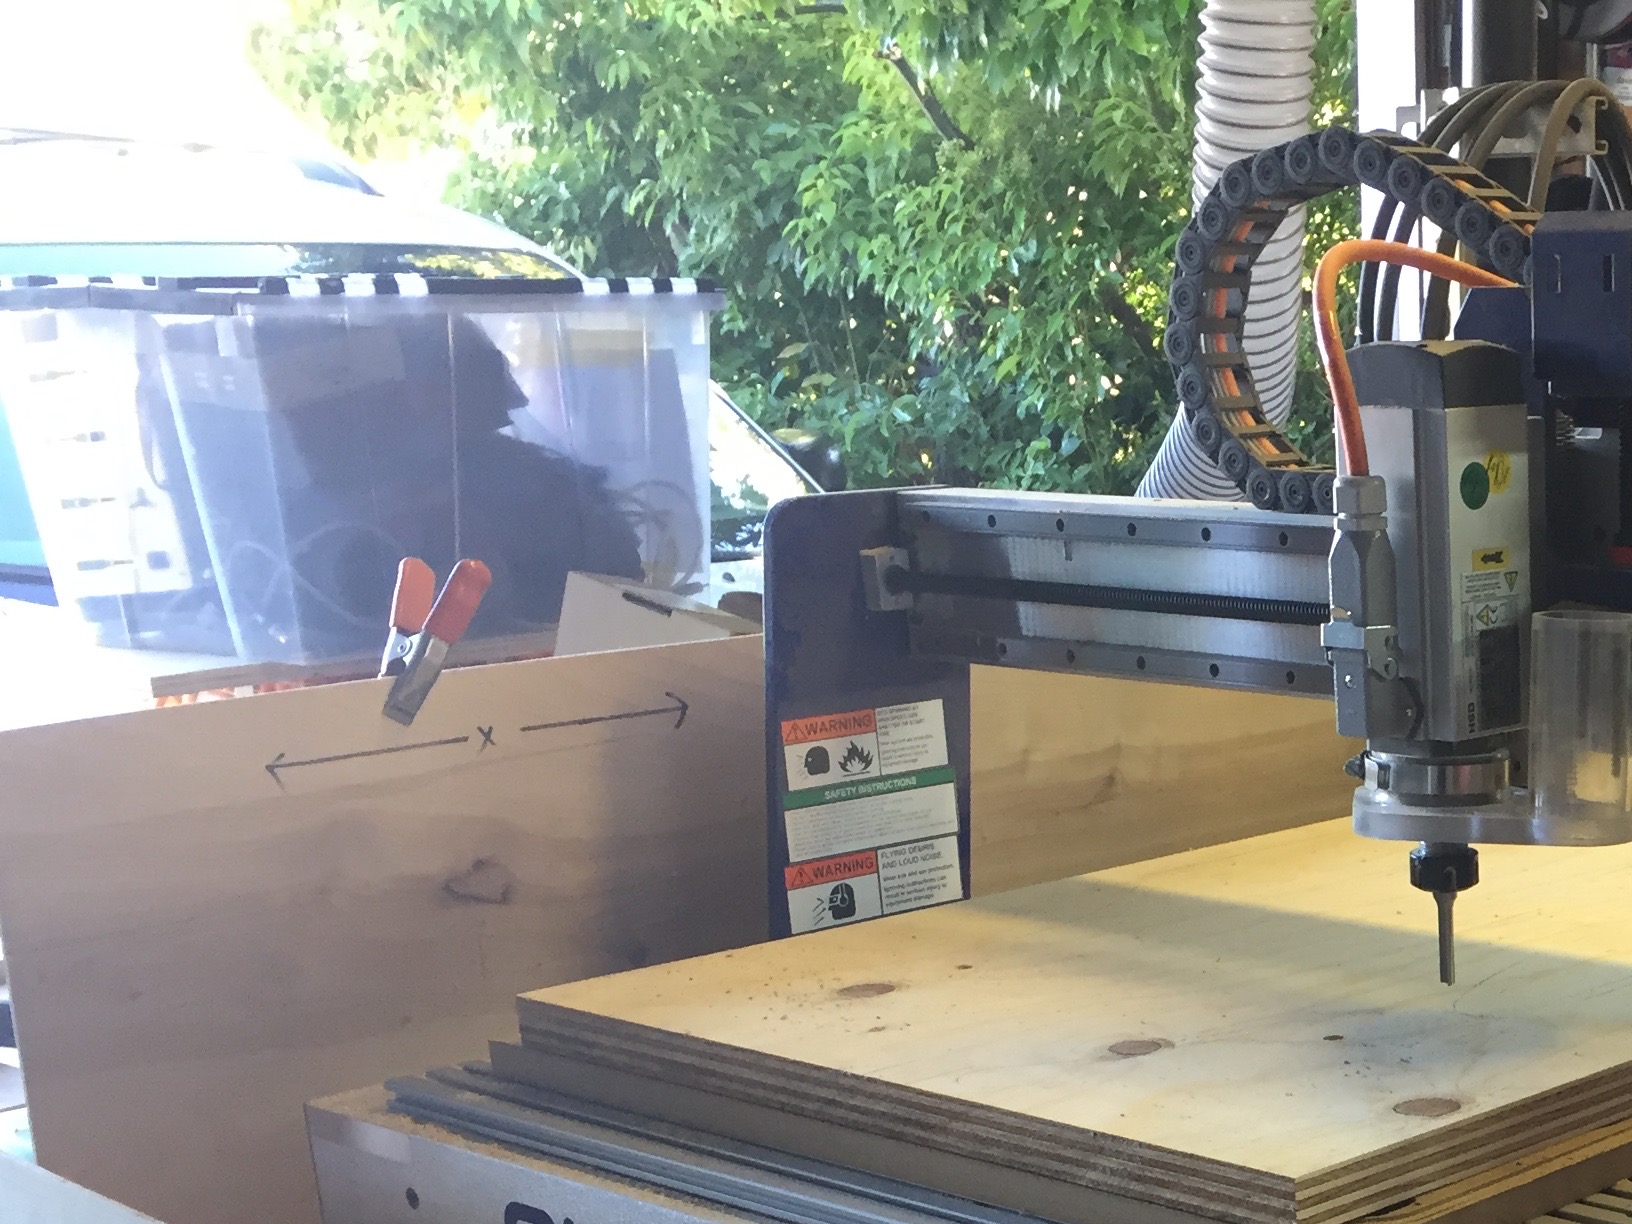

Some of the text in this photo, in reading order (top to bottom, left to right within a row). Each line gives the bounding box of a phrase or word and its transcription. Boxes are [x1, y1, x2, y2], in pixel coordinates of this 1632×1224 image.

[805, 714, 873, 736] WARNING
[824, 776, 917, 800] SAFETY INSTRUCTIONS
[812, 856, 874, 879] WARNING
